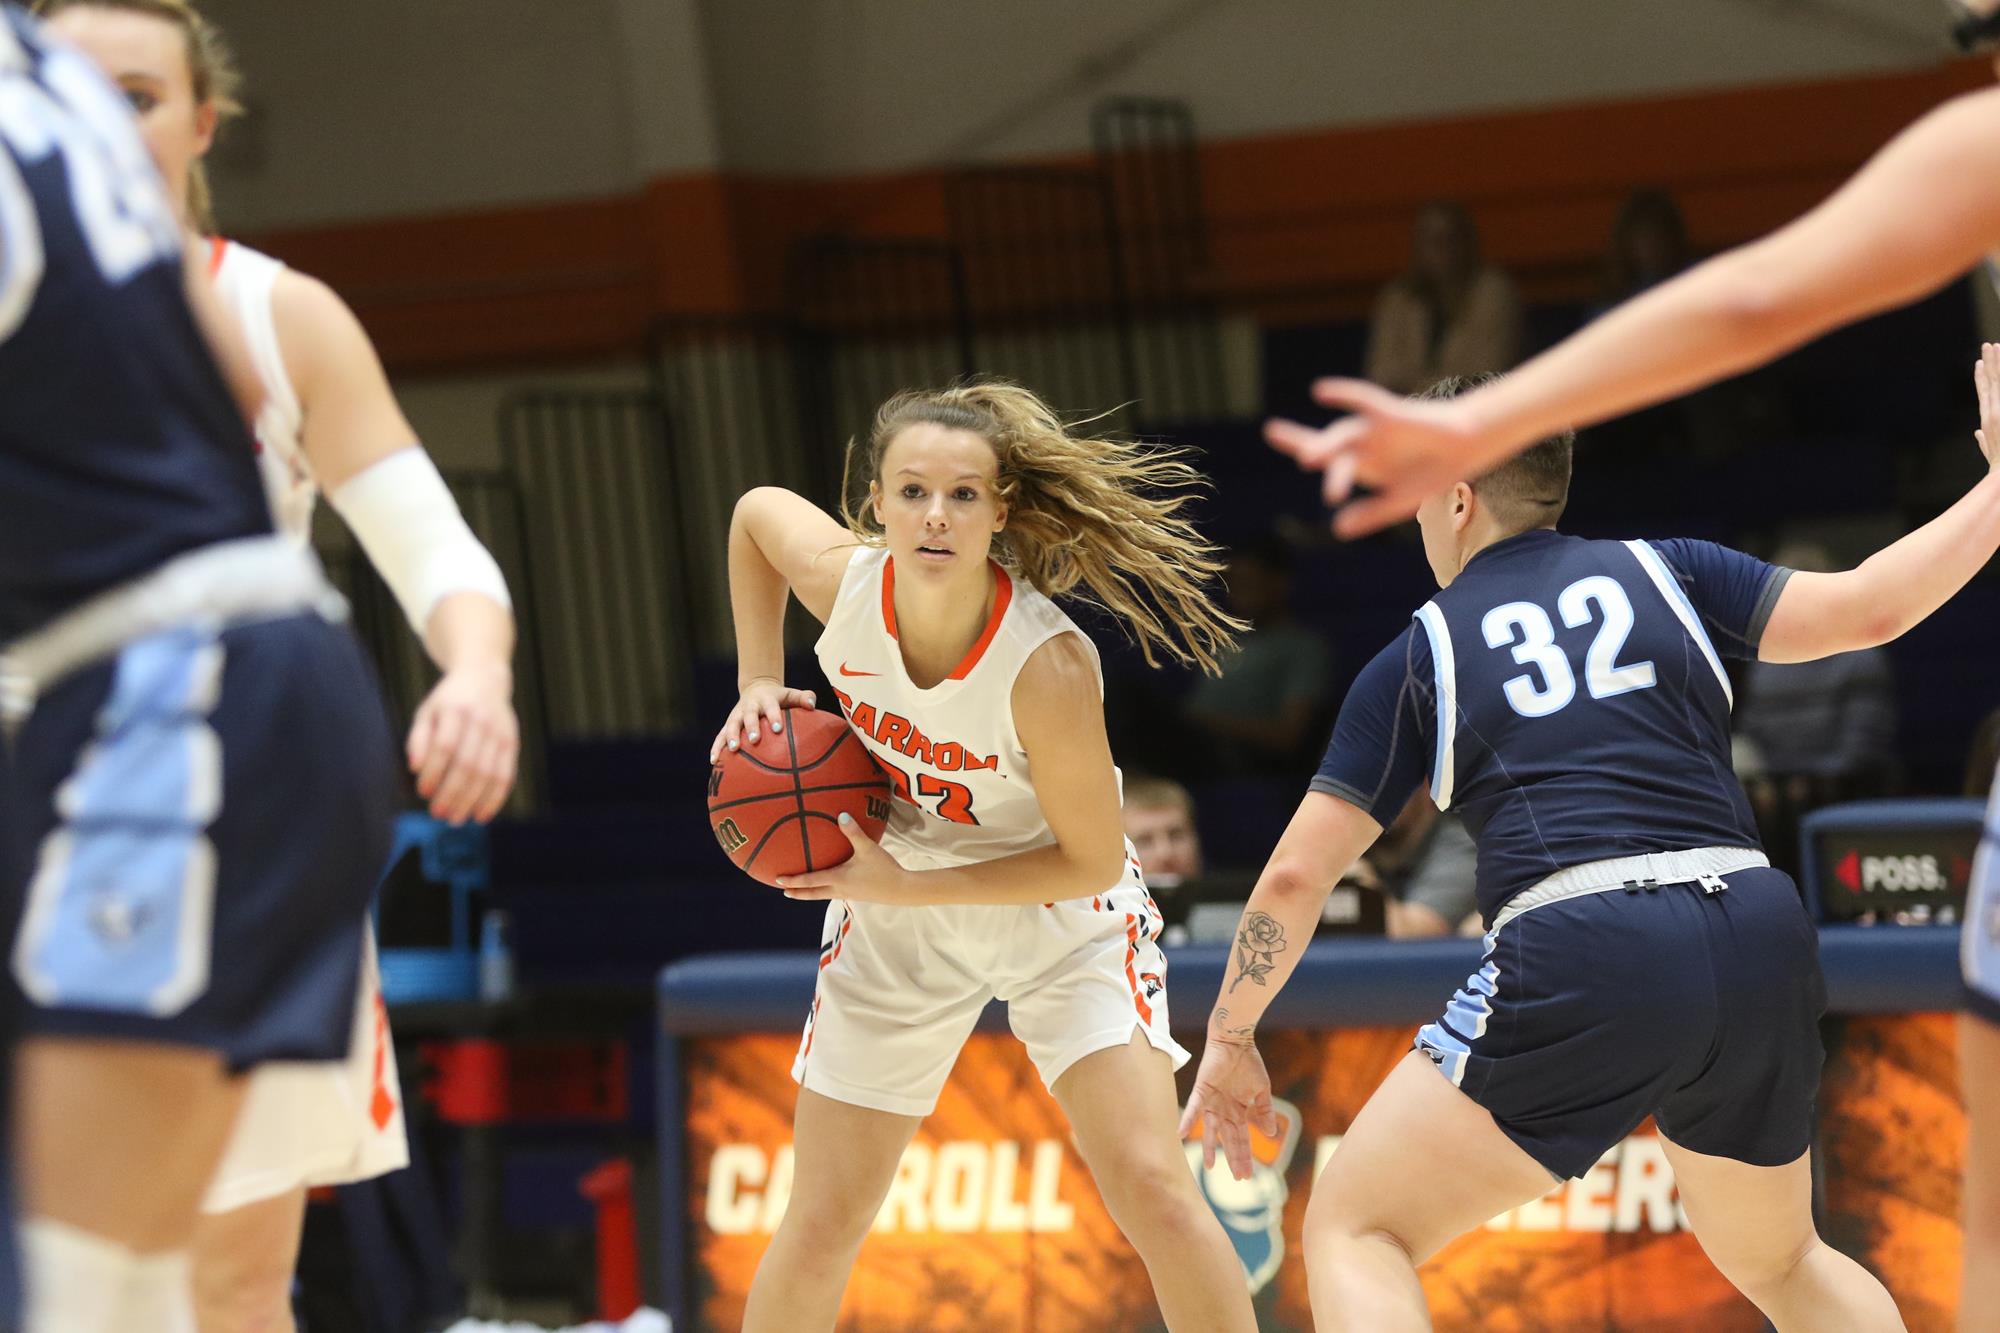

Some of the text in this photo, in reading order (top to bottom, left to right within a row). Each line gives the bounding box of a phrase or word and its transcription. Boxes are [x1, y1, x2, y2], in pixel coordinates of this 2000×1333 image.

[1481, 575, 1657, 718] 32
[832, 686, 1006, 778] CARROL
[1862, 854, 1947, 892] POSS.
[706, 1140, 1075, 1234] CROLL
